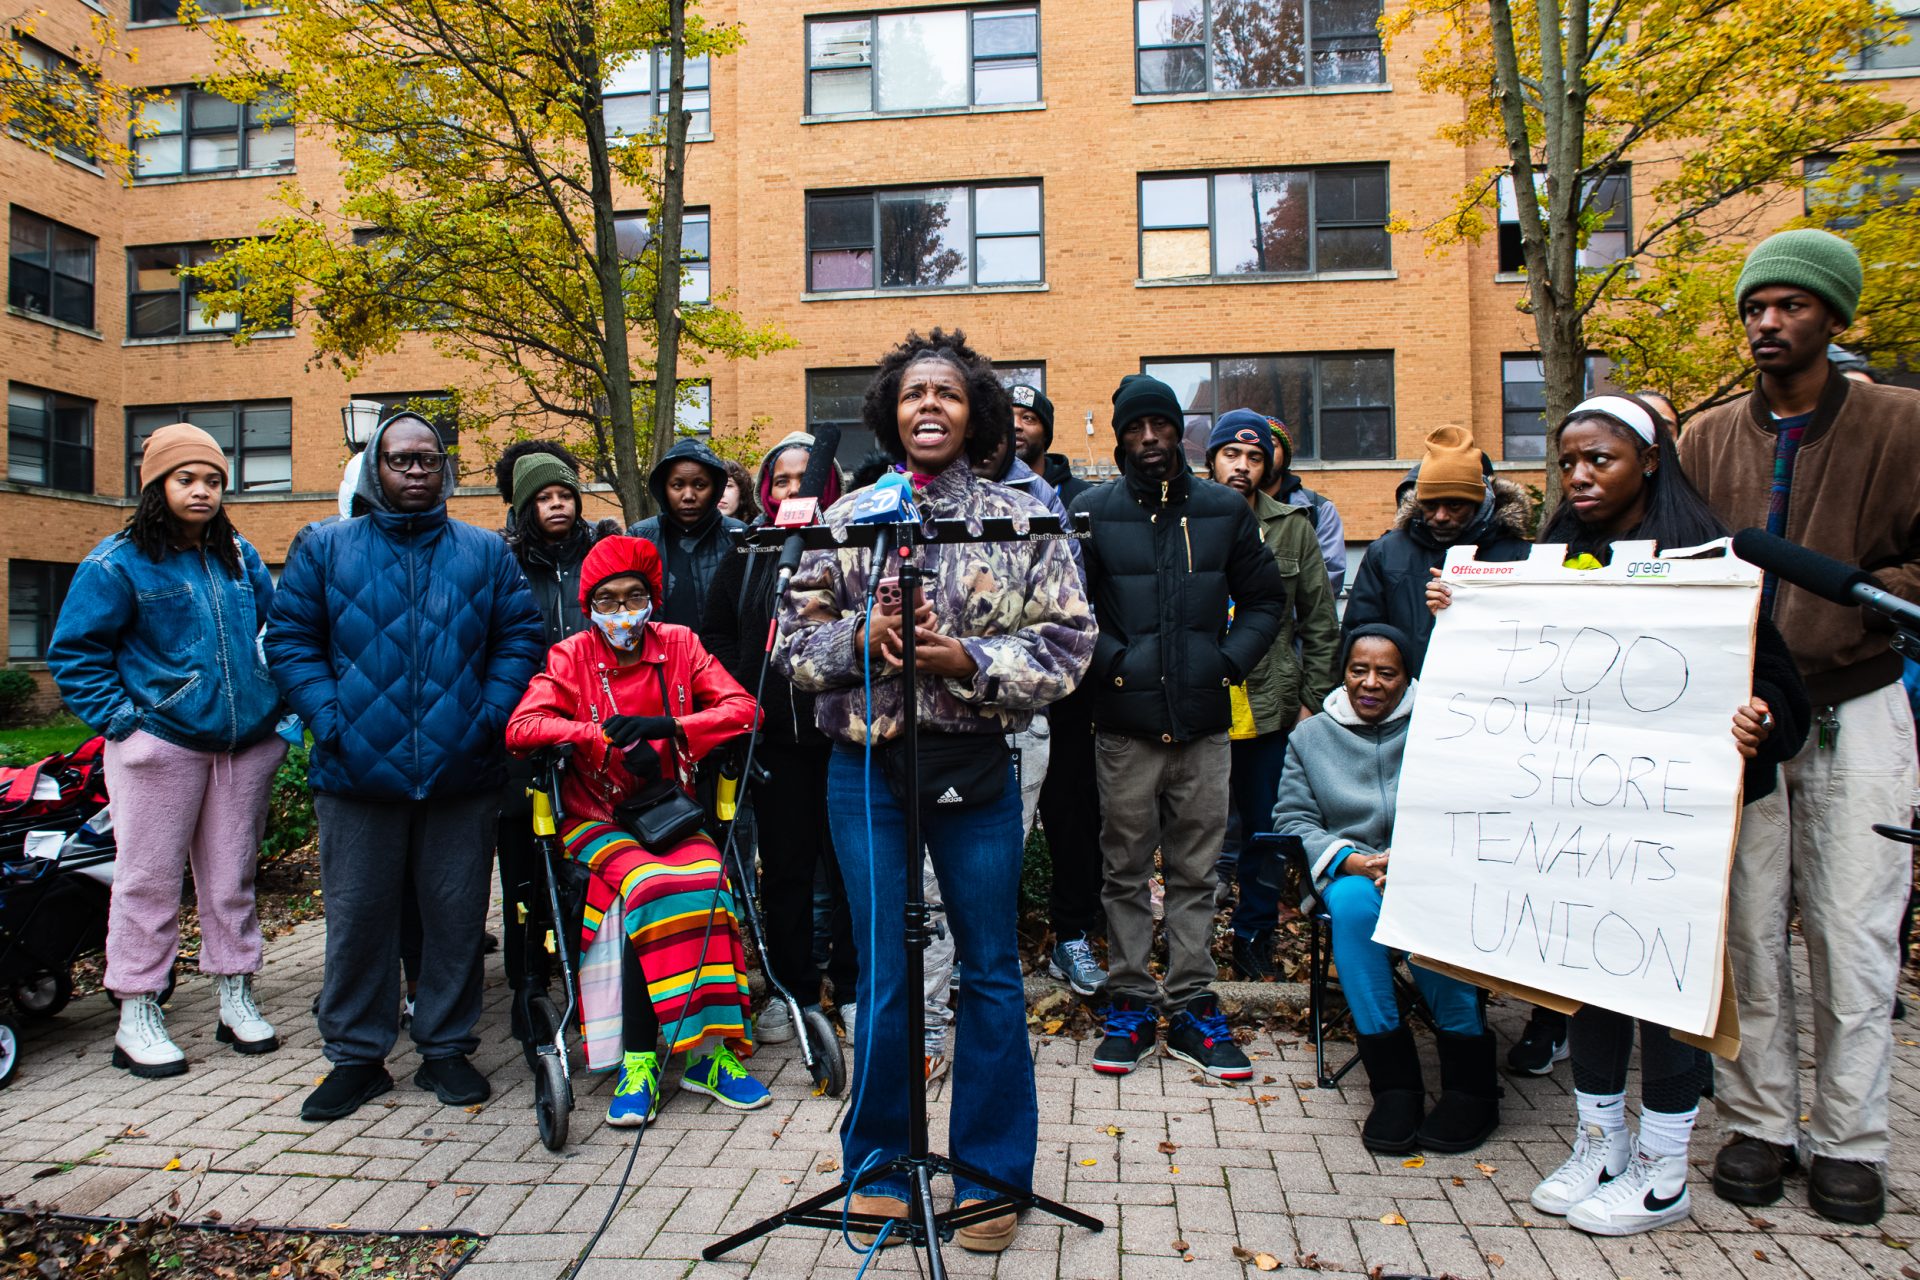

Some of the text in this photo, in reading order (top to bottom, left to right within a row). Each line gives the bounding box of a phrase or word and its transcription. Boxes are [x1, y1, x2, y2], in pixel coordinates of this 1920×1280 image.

[783, 510, 806, 521] 91.5
[1451, 565, 1482, 575] Office
[1626, 562, 1671, 578] green
[1497, 620, 1689, 713] 7500
[1435, 692, 1591, 752] SOUTH
[937, 796, 963, 804] adidas
[1510, 750, 1695, 818] SHORE
[1444, 811, 1676, 885] TENANTS
[1470, 882, 1691, 993] UNION
